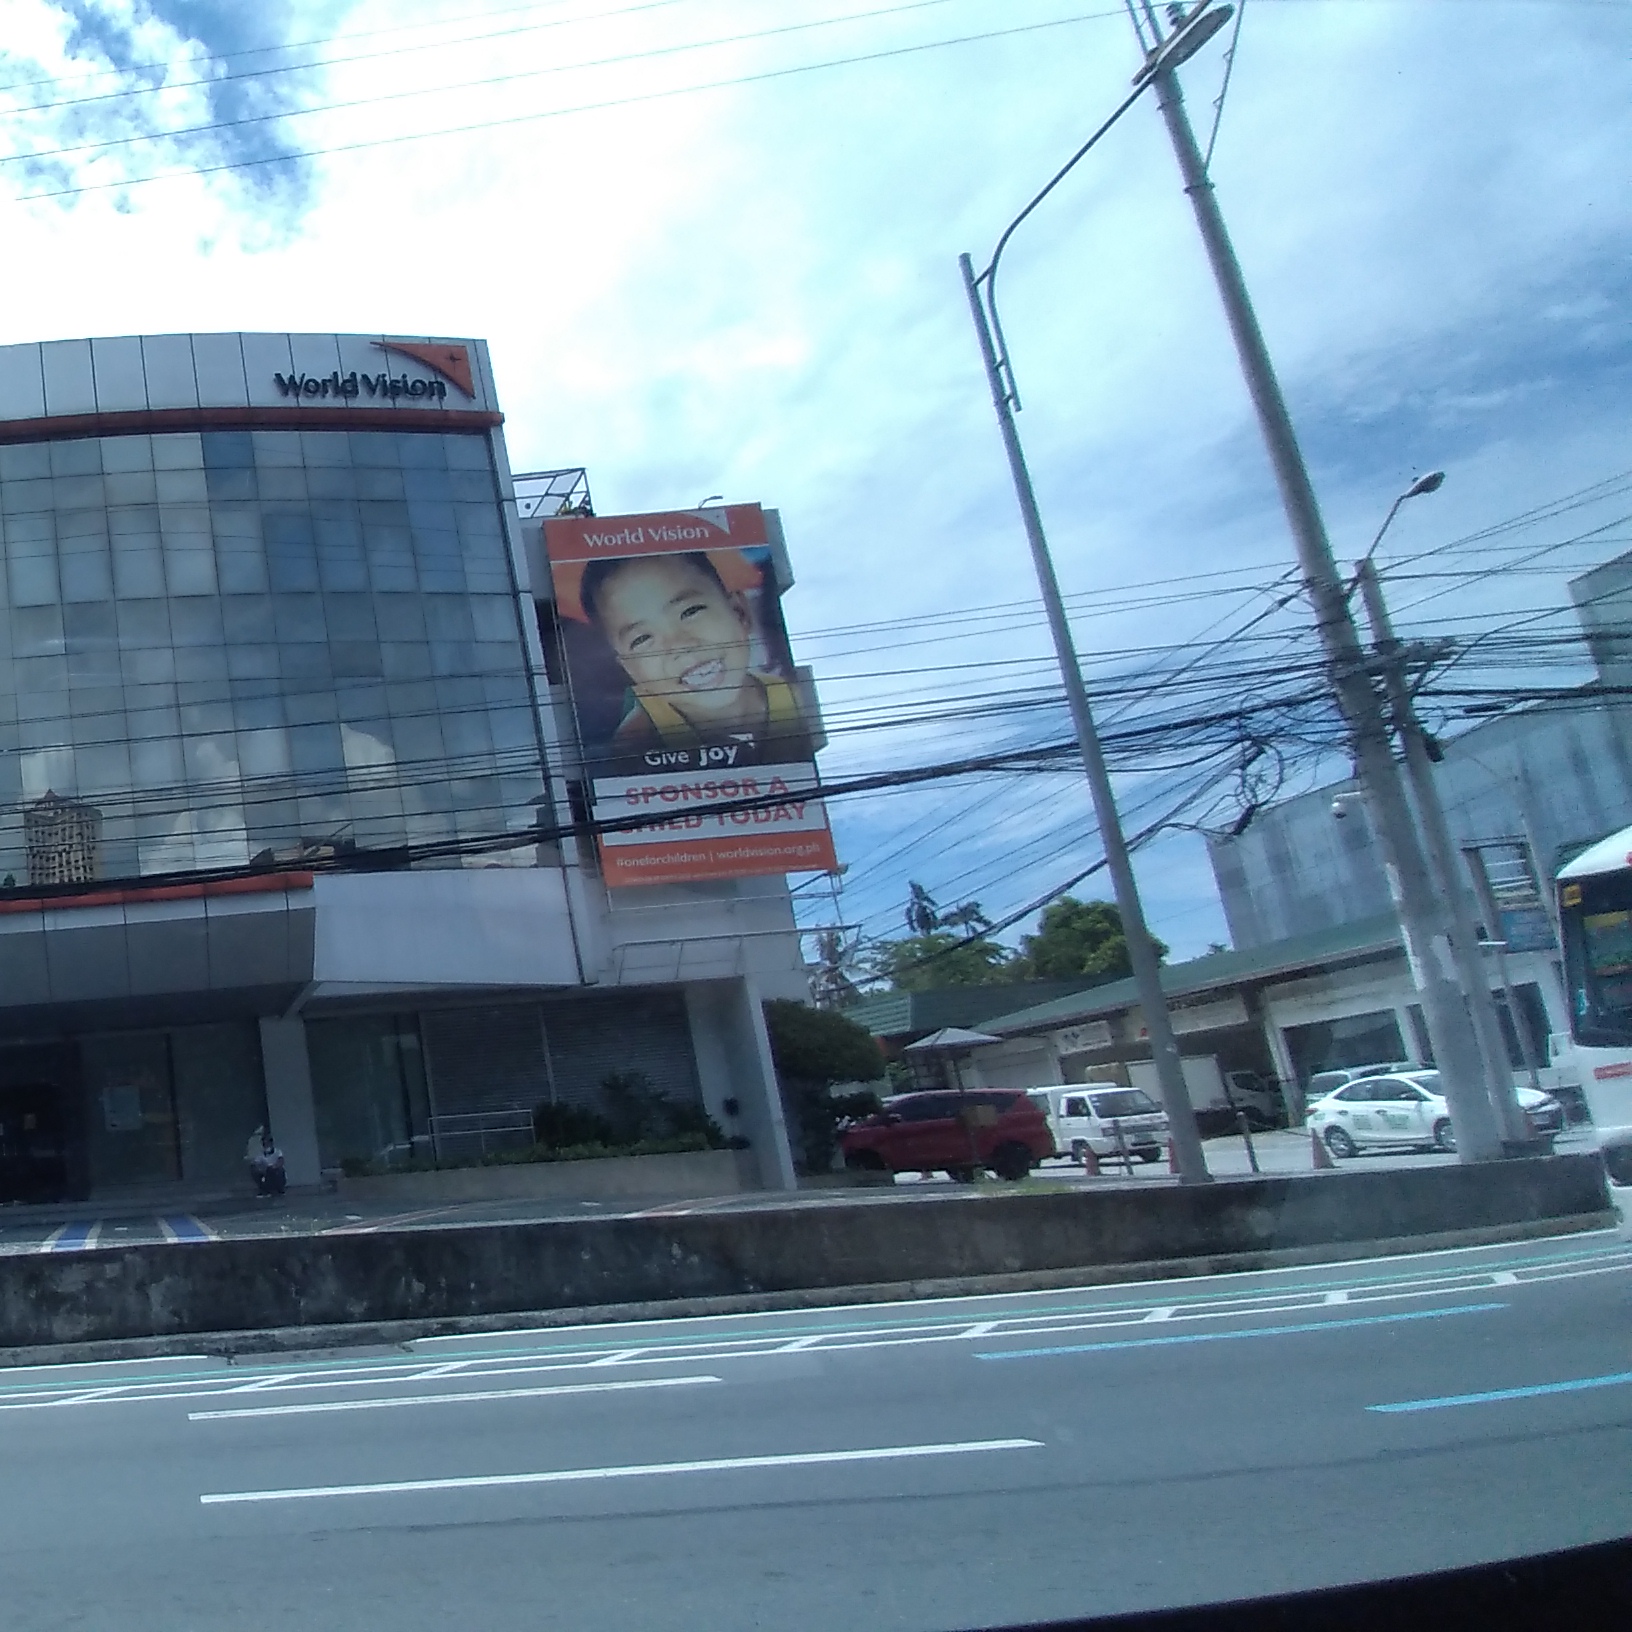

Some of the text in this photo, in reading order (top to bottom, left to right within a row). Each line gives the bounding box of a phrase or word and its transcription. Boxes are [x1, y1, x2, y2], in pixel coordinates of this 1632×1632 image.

[274, 371, 447, 398] World Vision
[583, 525, 709, 547] World Vision
[644, 749, 690, 766] Give
[625, 776, 789, 805] SPONSOR A
